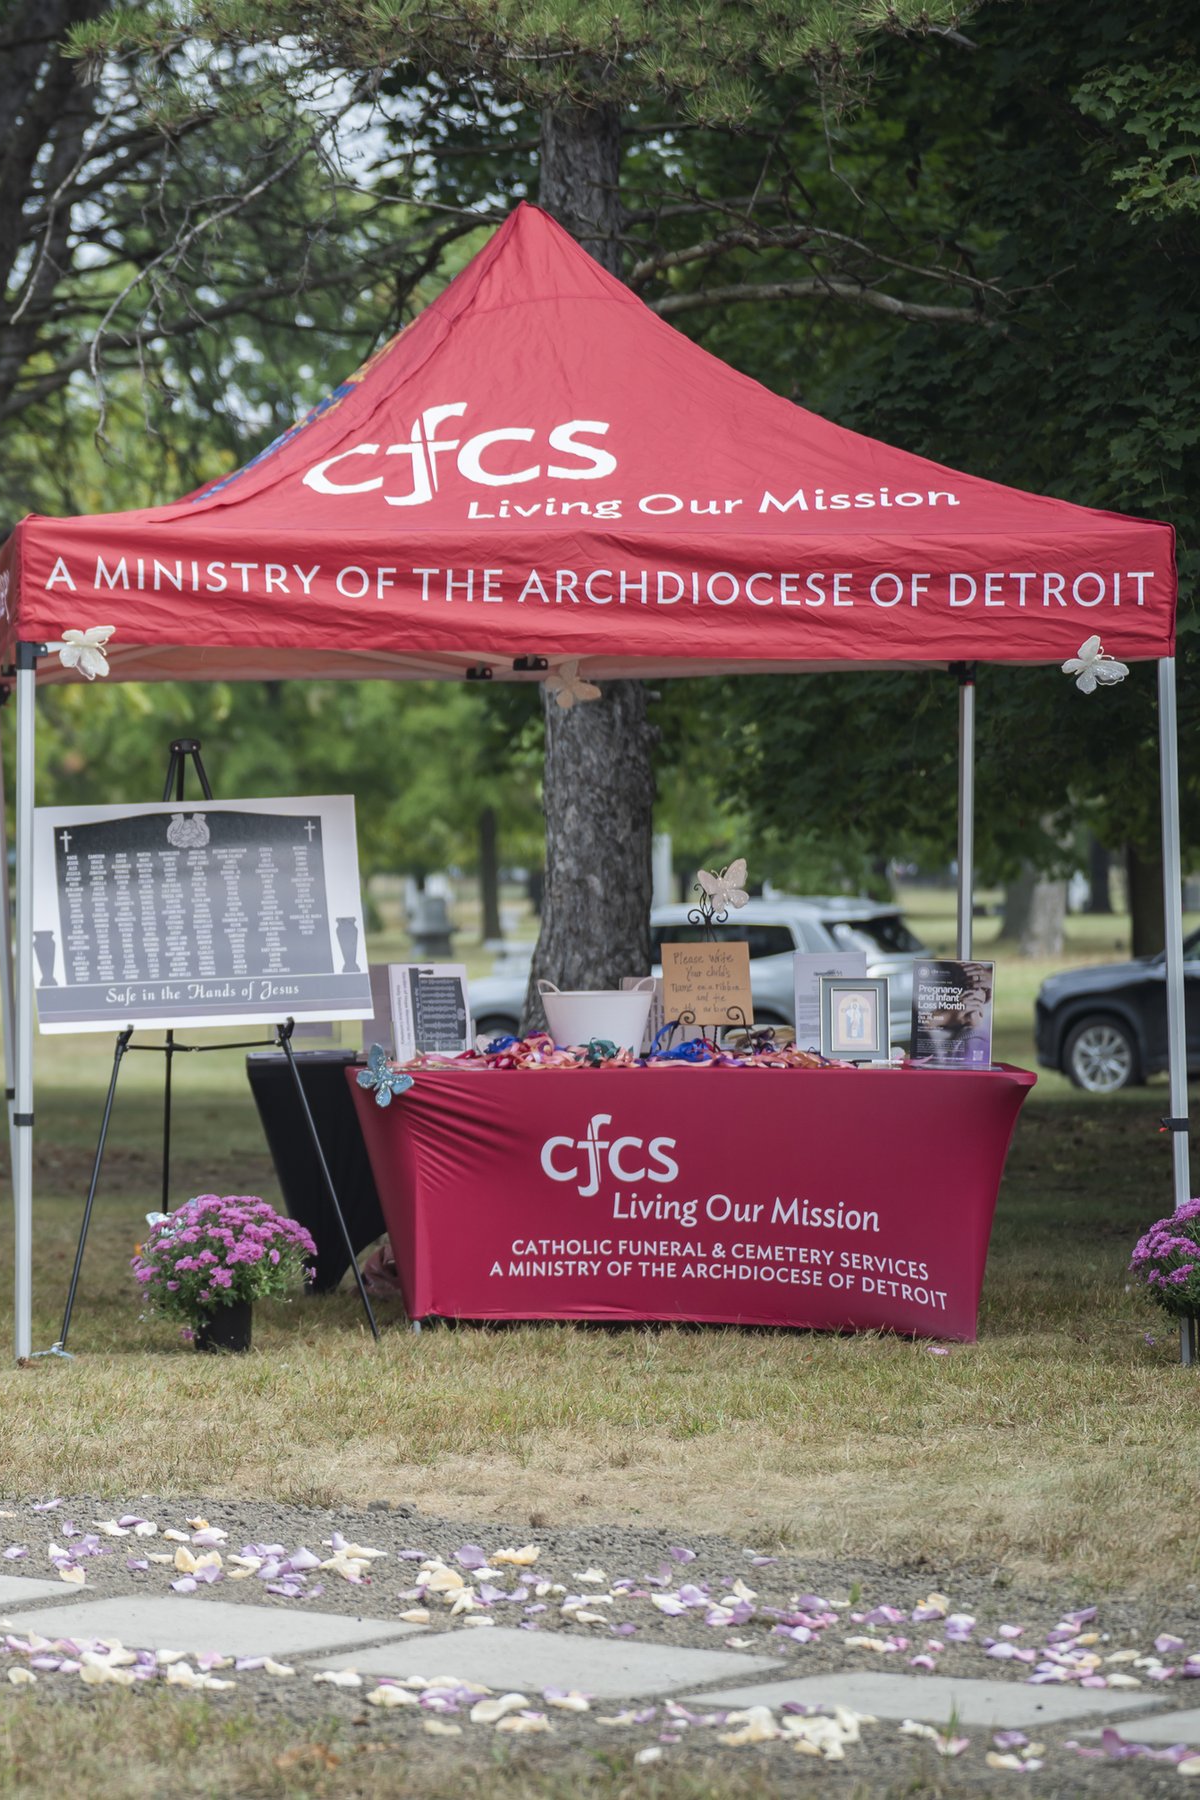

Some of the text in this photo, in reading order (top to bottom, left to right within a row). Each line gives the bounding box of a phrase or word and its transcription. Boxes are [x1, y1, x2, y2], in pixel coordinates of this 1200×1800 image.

[468, 486, 960, 520] Living Our Mission
[45, 554, 1155, 608] A MINISTRY OF THE ARCHDIOCESE OF DETROIT
[673, 952, 704, 964] Please
[106, 981, 299, 1006] Safe in the Hands of Jesus
[918, 984, 963, 994] Pregnancy
[936, 994, 960, 1002] Infant
[938, 1002, 966, 1010] Month
[612, 1192, 880, 1233] Living Our Mission
[511, 1239, 929, 1281] CATHOLIC FUNERAL & CEMETERY SERVICES
[489, 1260, 948, 1310] A MINISTRY OF THE ARCHDIOCESE OF DETROIT
